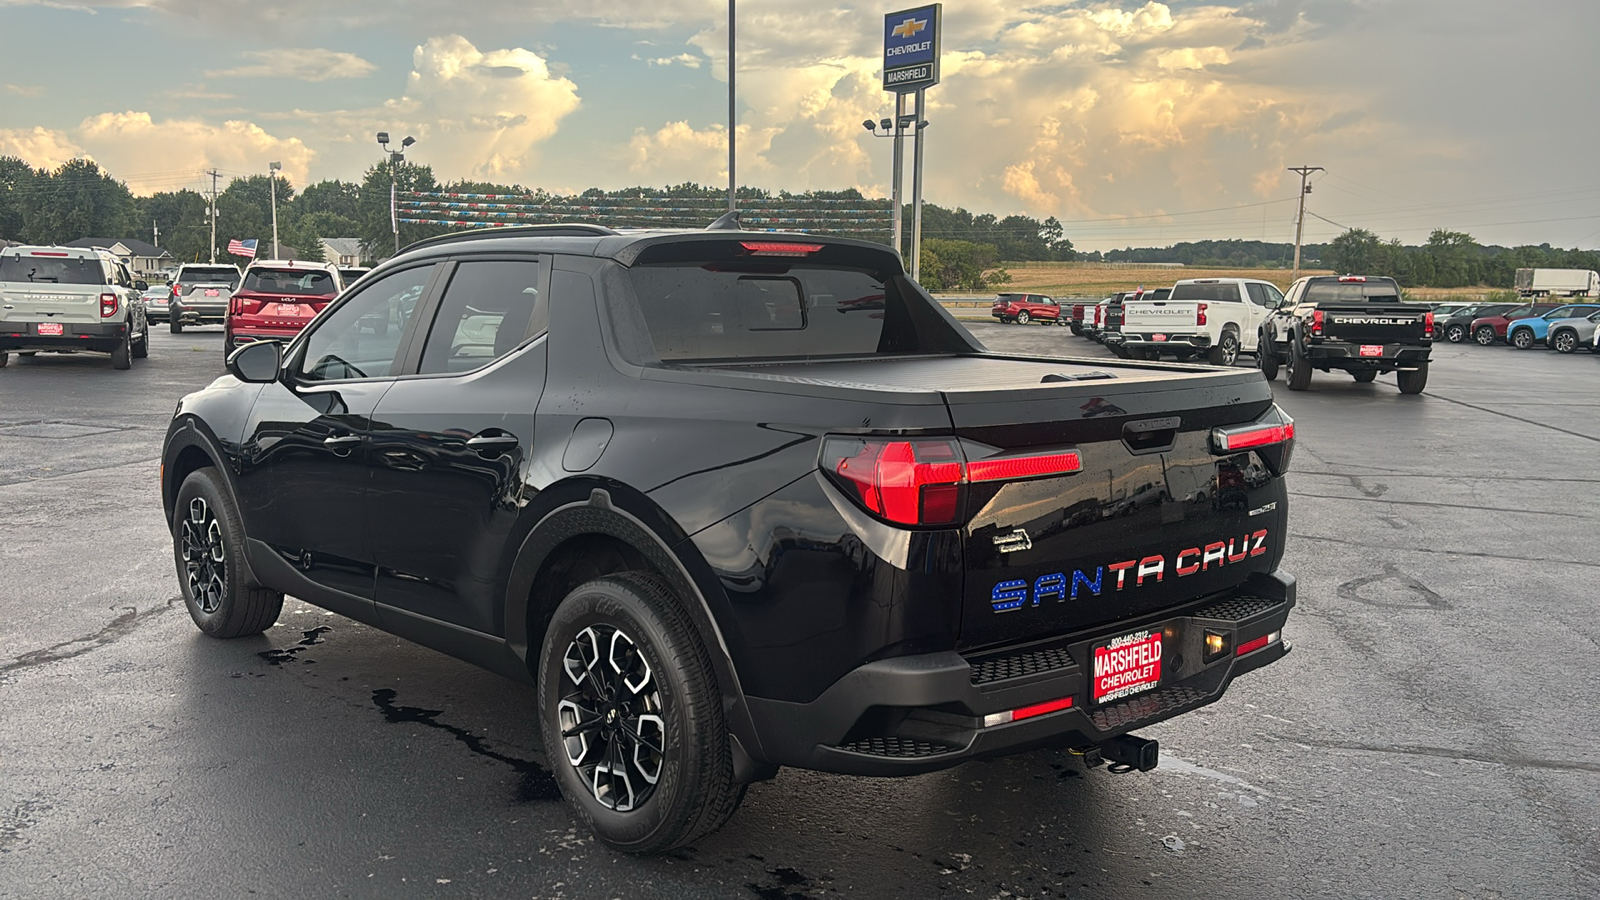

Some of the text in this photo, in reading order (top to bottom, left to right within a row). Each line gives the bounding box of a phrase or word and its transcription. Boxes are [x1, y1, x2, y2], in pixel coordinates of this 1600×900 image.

[886, 41, 931, 56] CHEVROLET
[887, 67, 927, 82] MARSHFIELD
[991, 528, 1268, 613] SANTA CRUZ
[1093, 640, 1162, 678] MARSHFIELD
[1101, 665, 1154, 690] CHEVROLET
[1098, 688, 1129, 704] MARSHFIELD
[1129, 680, 1158, 695] CHEVROLET
